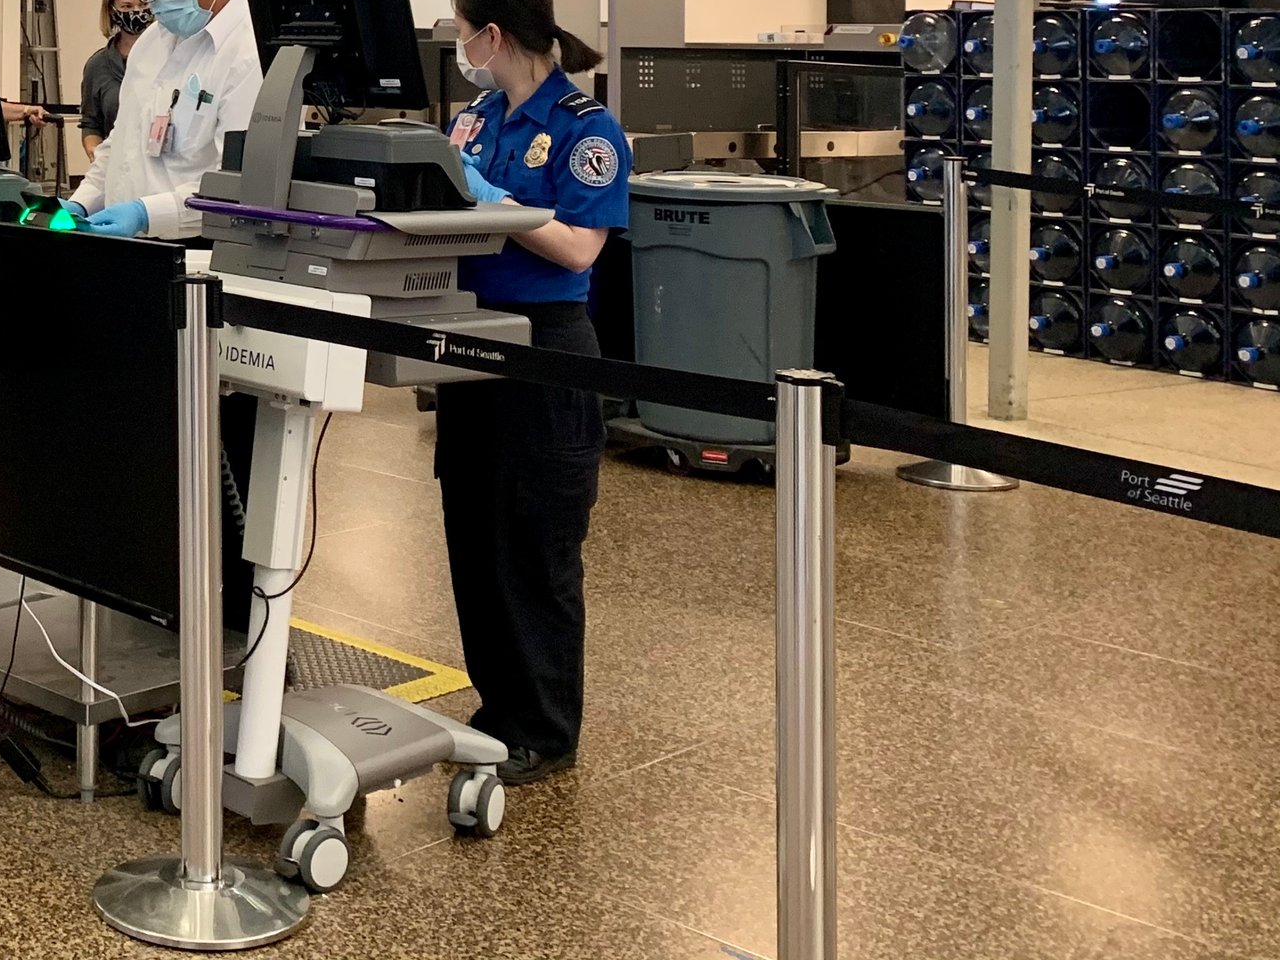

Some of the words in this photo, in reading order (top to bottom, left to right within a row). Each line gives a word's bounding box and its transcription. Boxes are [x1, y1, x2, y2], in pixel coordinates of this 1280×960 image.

[654, 208, 710, 224] BRUTE
[226, 345, 276, 371] IDEMIA
[449, 344, 466, 356] Port
[467, 347, 475, 357] of
[476, 348, 506, 362] Seattle
[1121, 470, 1150, 488] Port
[1127, 488, 1142, 499] of
[1144, 489, 1192, 511] Seattle
